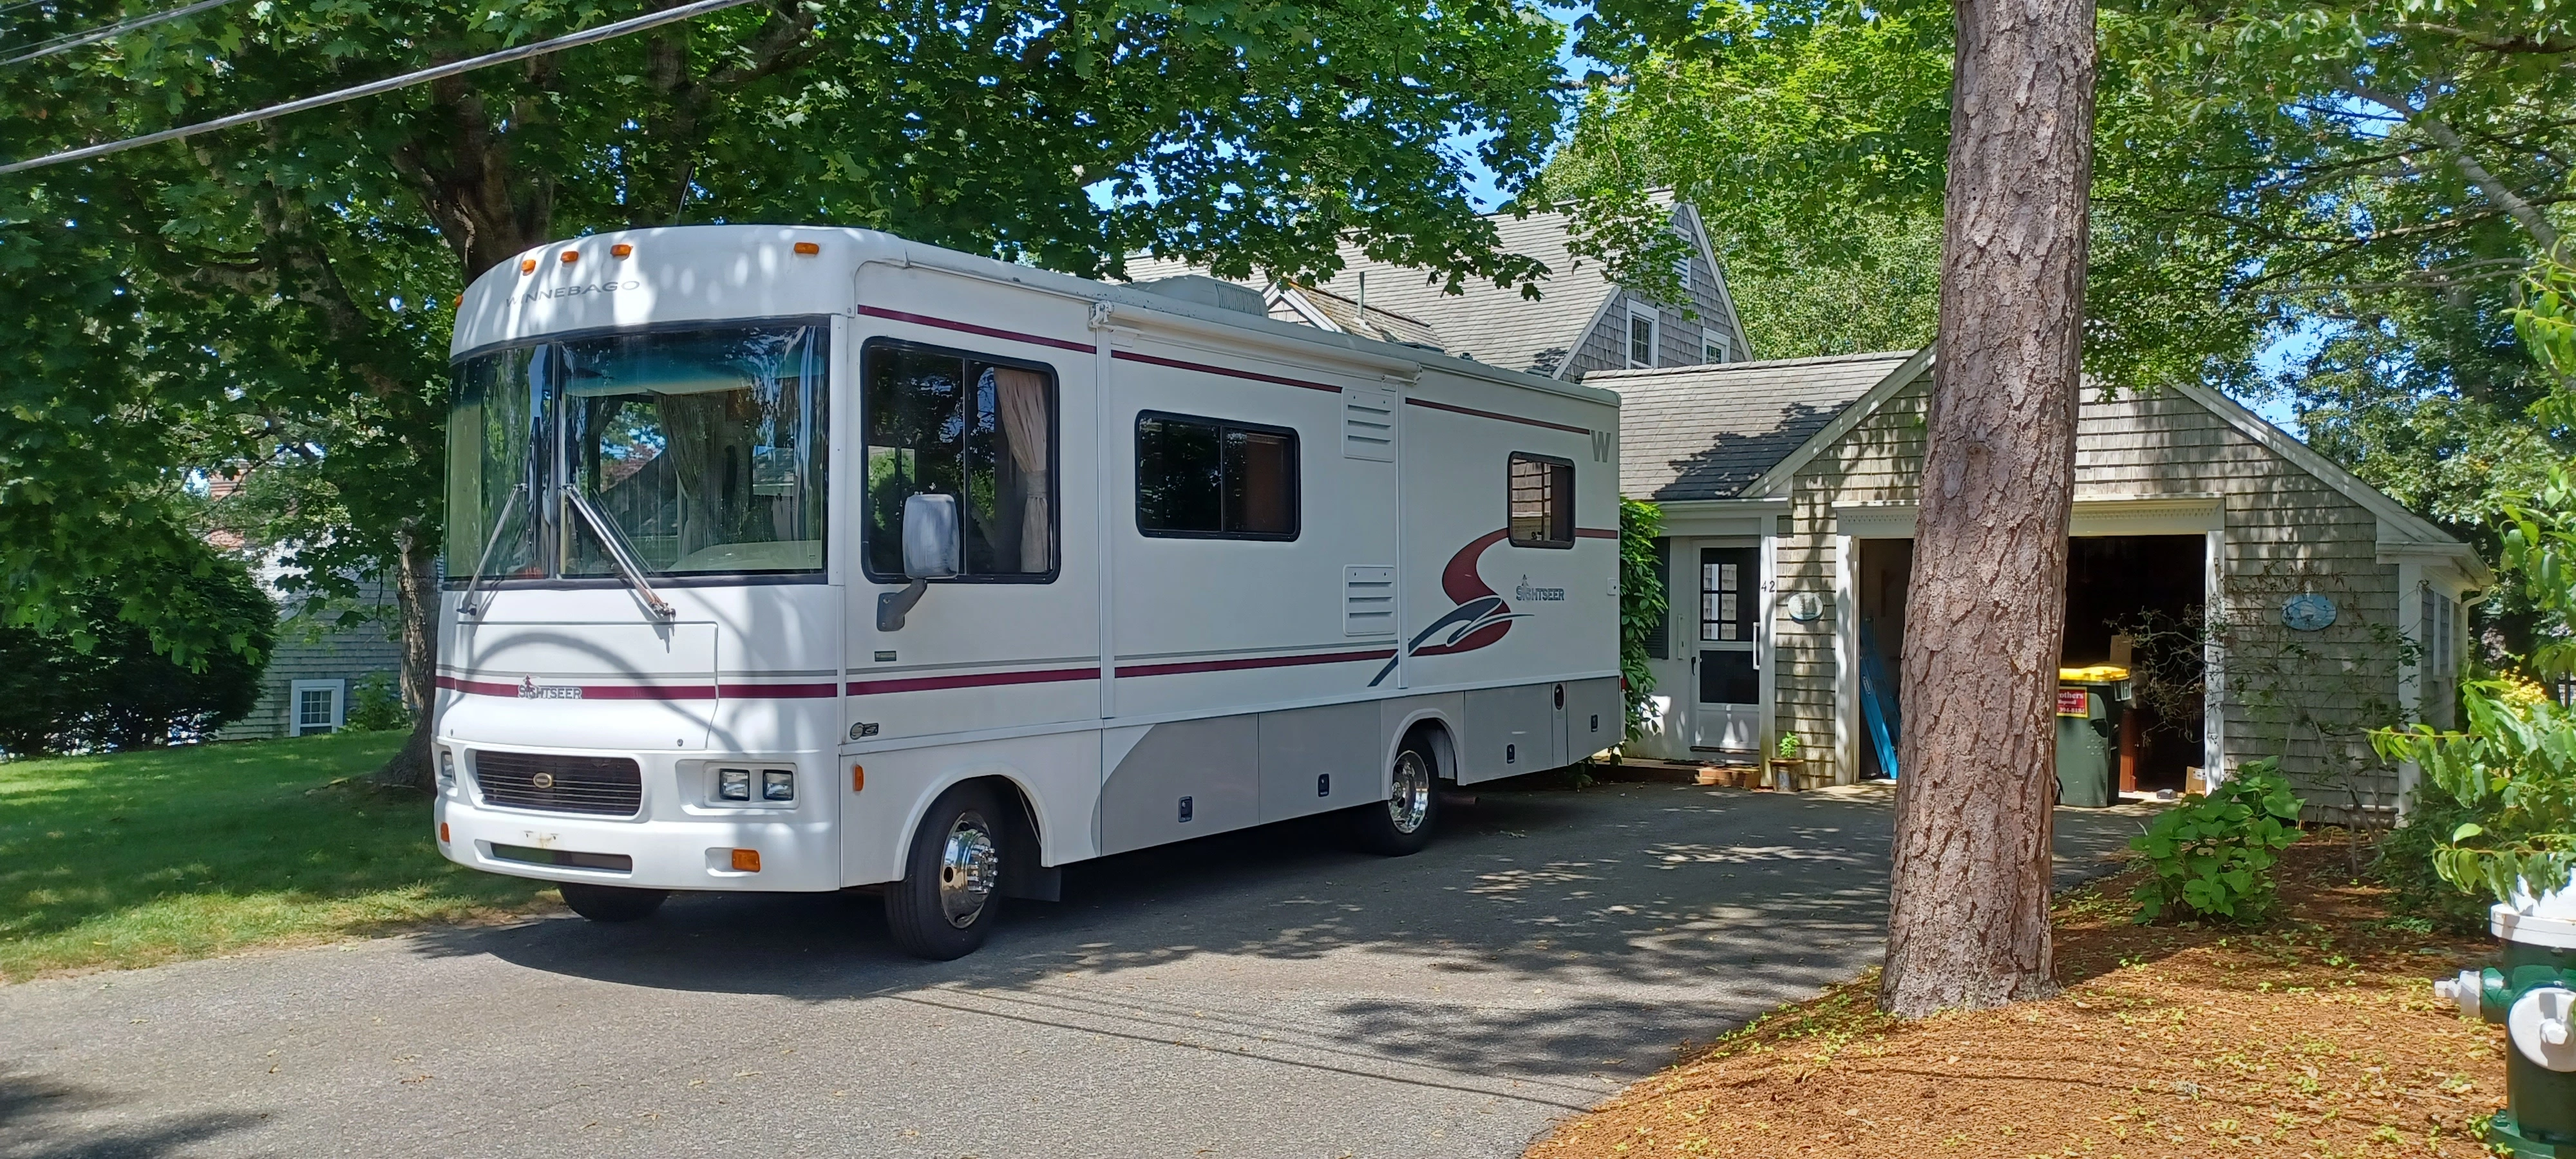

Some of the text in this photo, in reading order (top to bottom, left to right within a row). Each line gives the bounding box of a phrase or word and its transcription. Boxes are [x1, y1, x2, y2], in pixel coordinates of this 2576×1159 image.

[506, 281, 639, 307] WINNEBAGO
[1591, 429, 1611, 463] W
[1761, 580, 1776, 593] 42
